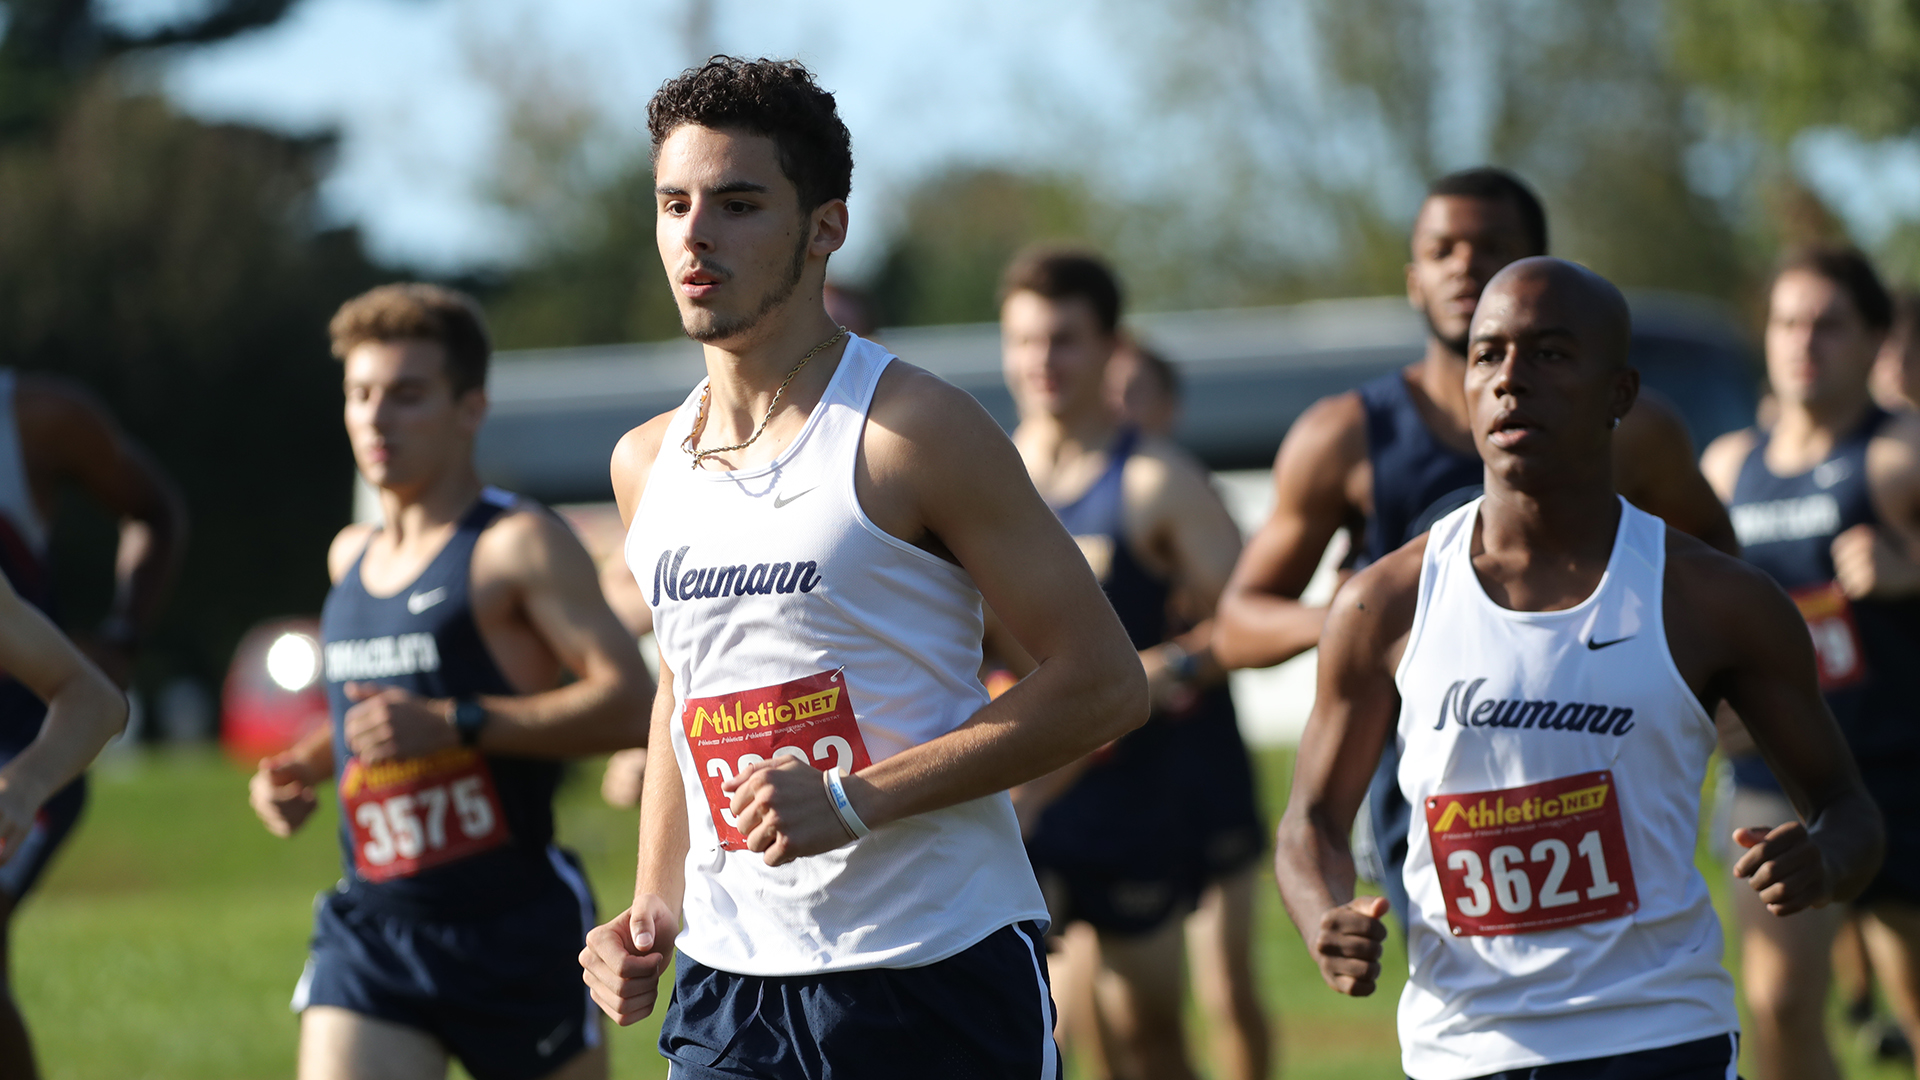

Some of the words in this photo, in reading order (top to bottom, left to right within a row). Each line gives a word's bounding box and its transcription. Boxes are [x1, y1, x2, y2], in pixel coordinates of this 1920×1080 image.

[651, 545, 822, 607] Neumann
[1433, 677, 1635, 736] Neumann
[355, 775, 496, 866] 3575
[706, 735, 854, 828] 32
[1447, 830, 1620, 918] 3621
